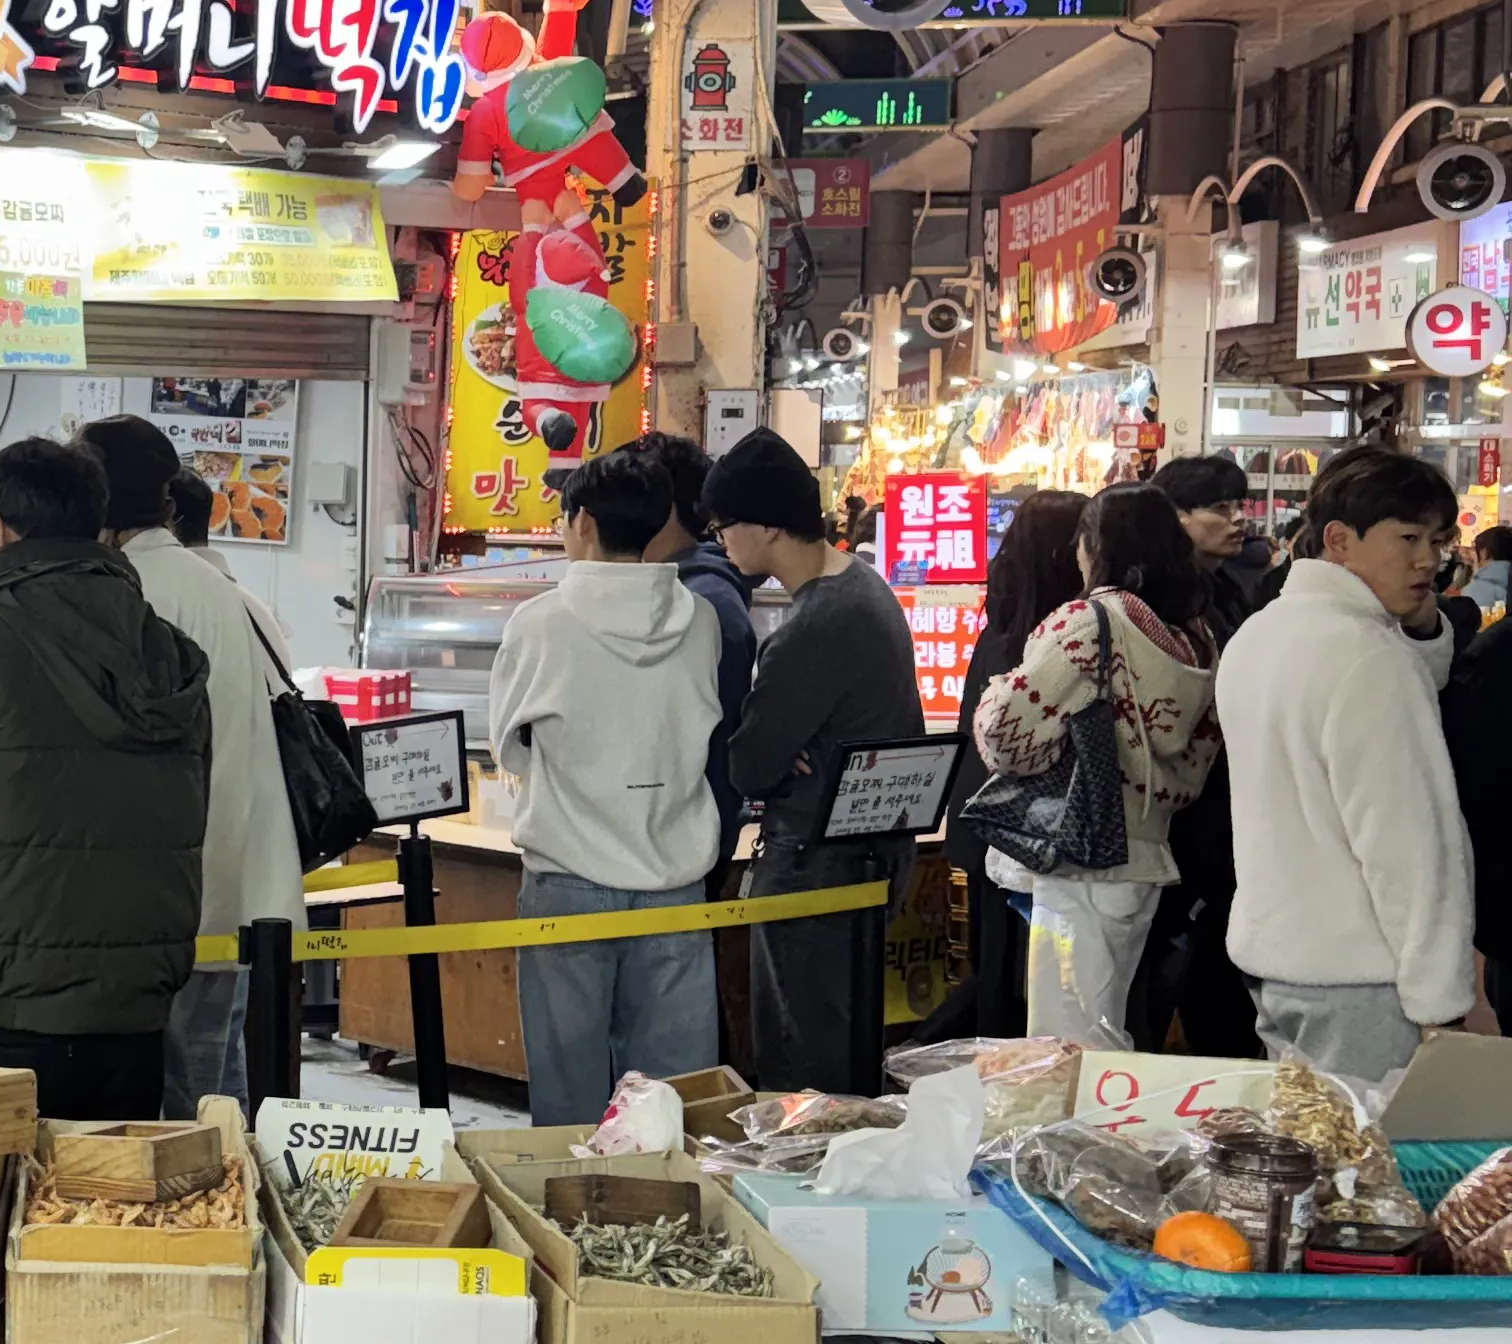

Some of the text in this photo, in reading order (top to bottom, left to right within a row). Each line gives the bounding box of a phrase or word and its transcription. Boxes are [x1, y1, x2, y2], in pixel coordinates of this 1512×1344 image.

[523, 70, 553, 101] Merry
[276, 193, 308, 221] 가능
[821, 187, 862, 203] 호스릴
[821, 202, 862, 217] 소화전
[1425, 300, 1491, 361] 약
[899, 484, 972, 526] 원조
[896, 530, 976, 570] 元祖
[907, 607, 957, 633] 혜향
[915, 641, 957, 668] 라봉
[363, 733, 383, 747] Out
[886, 771, 936, 793] 구매하실
[287, 1122, 420, 1153] FITNESS
[474, 1266, 485, 1294] NAQS
